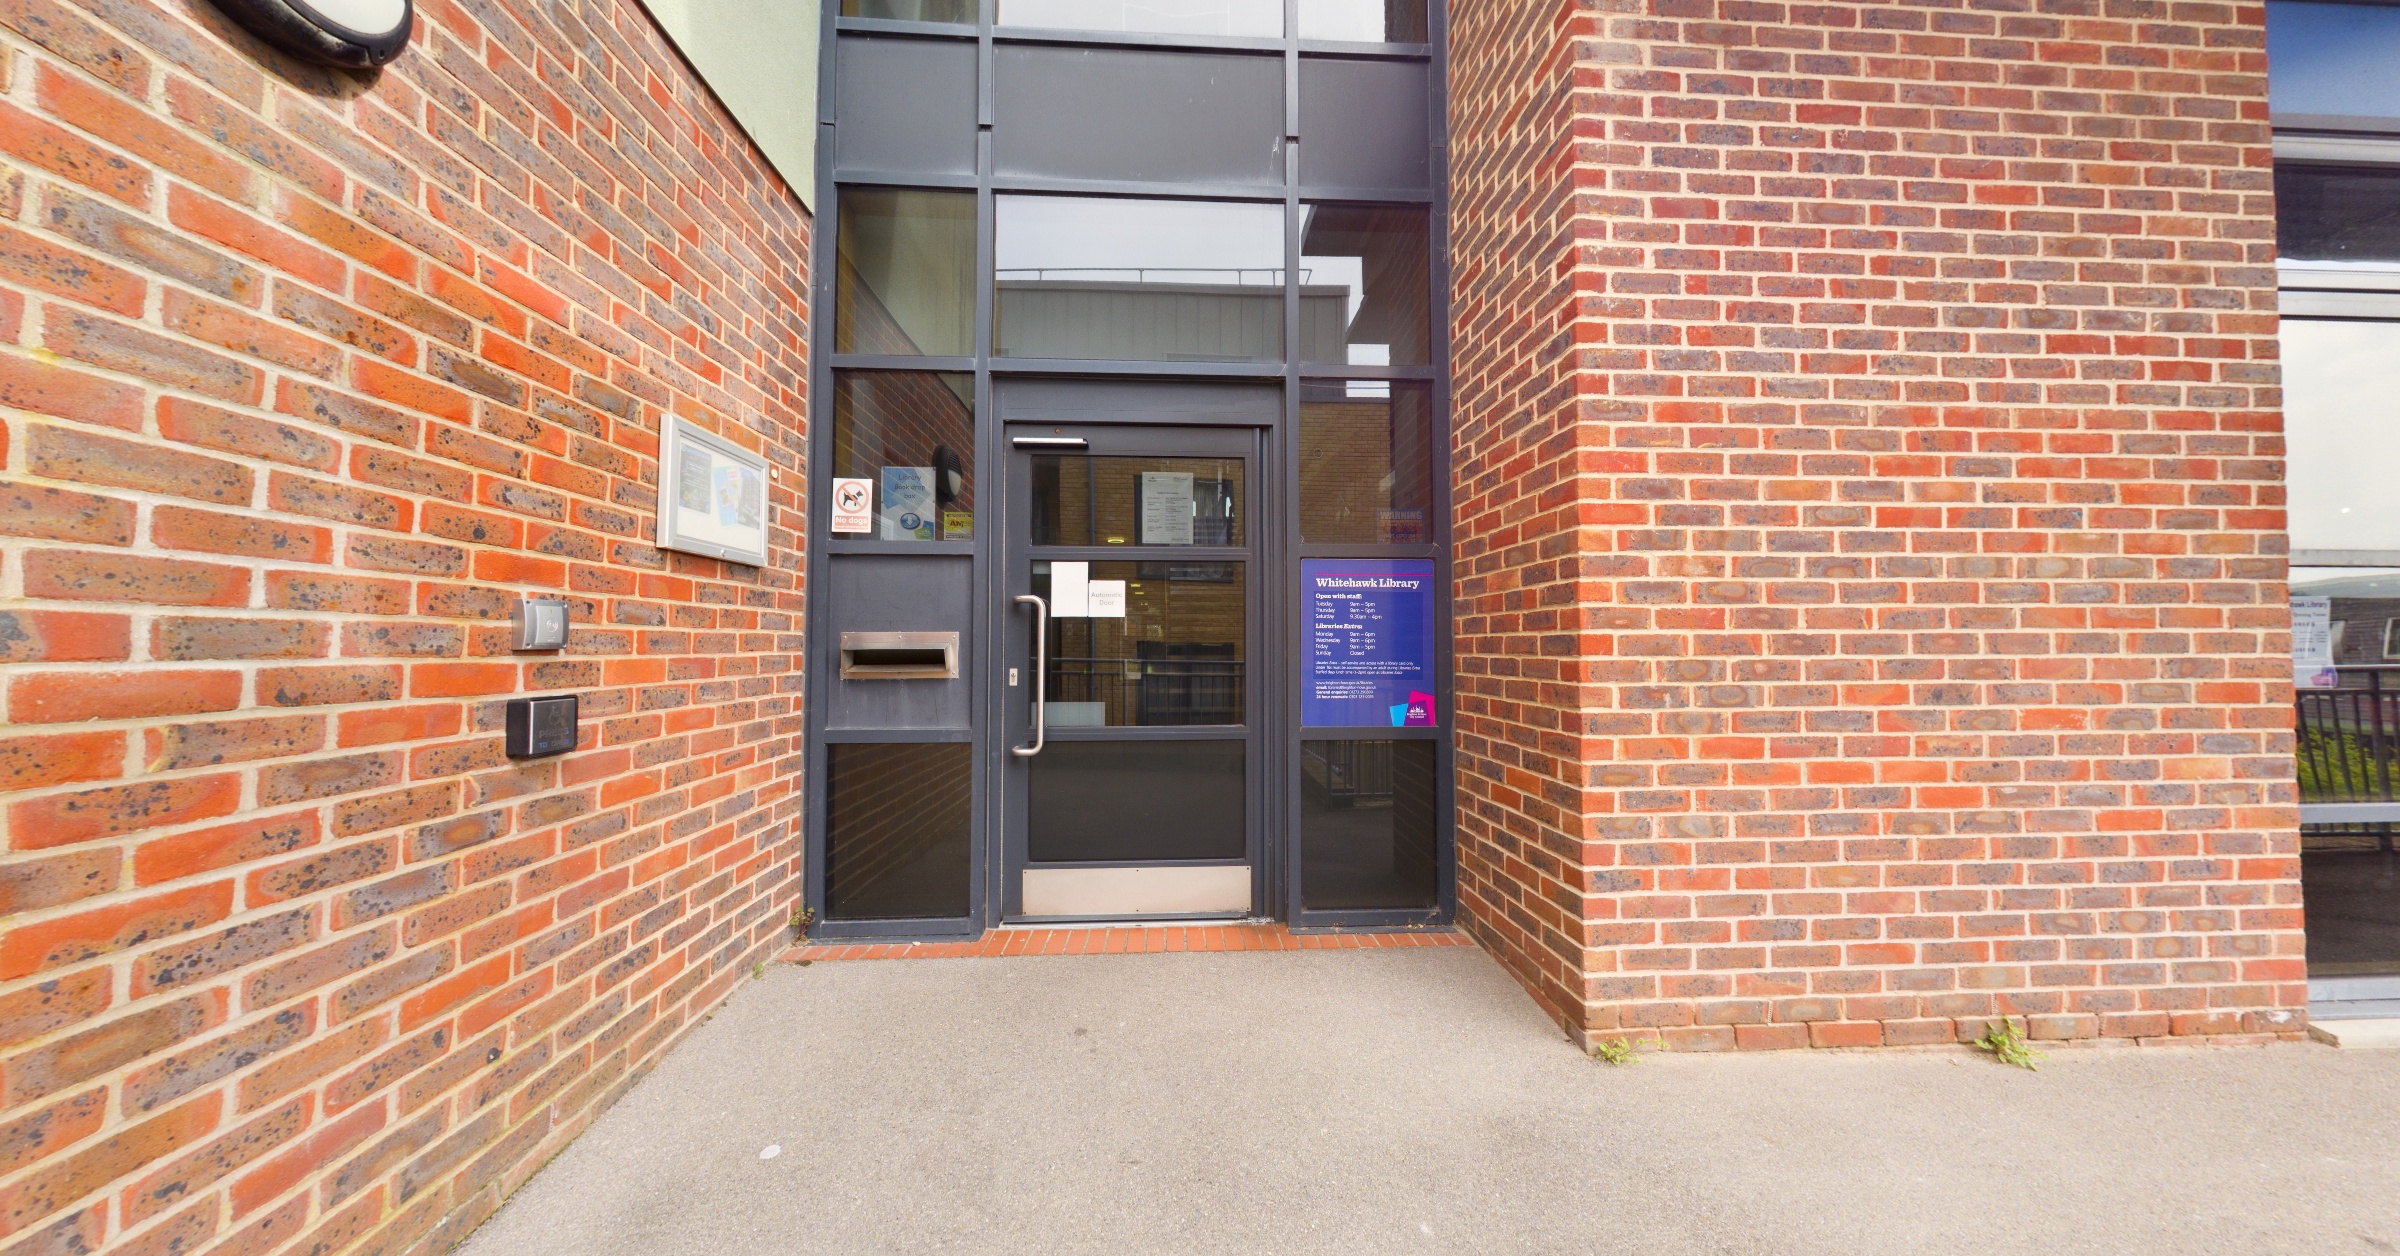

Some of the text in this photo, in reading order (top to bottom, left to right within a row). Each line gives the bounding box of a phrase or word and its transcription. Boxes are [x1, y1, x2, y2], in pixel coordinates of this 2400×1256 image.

[836, 516, 847, 524] No
[1315, 577, 1419, 590] Whitehawk Library
[1315, 592, 1331, 600] Open
[539, 727, 570, 739] PRESS
[538, 741, 548, 749] TO
